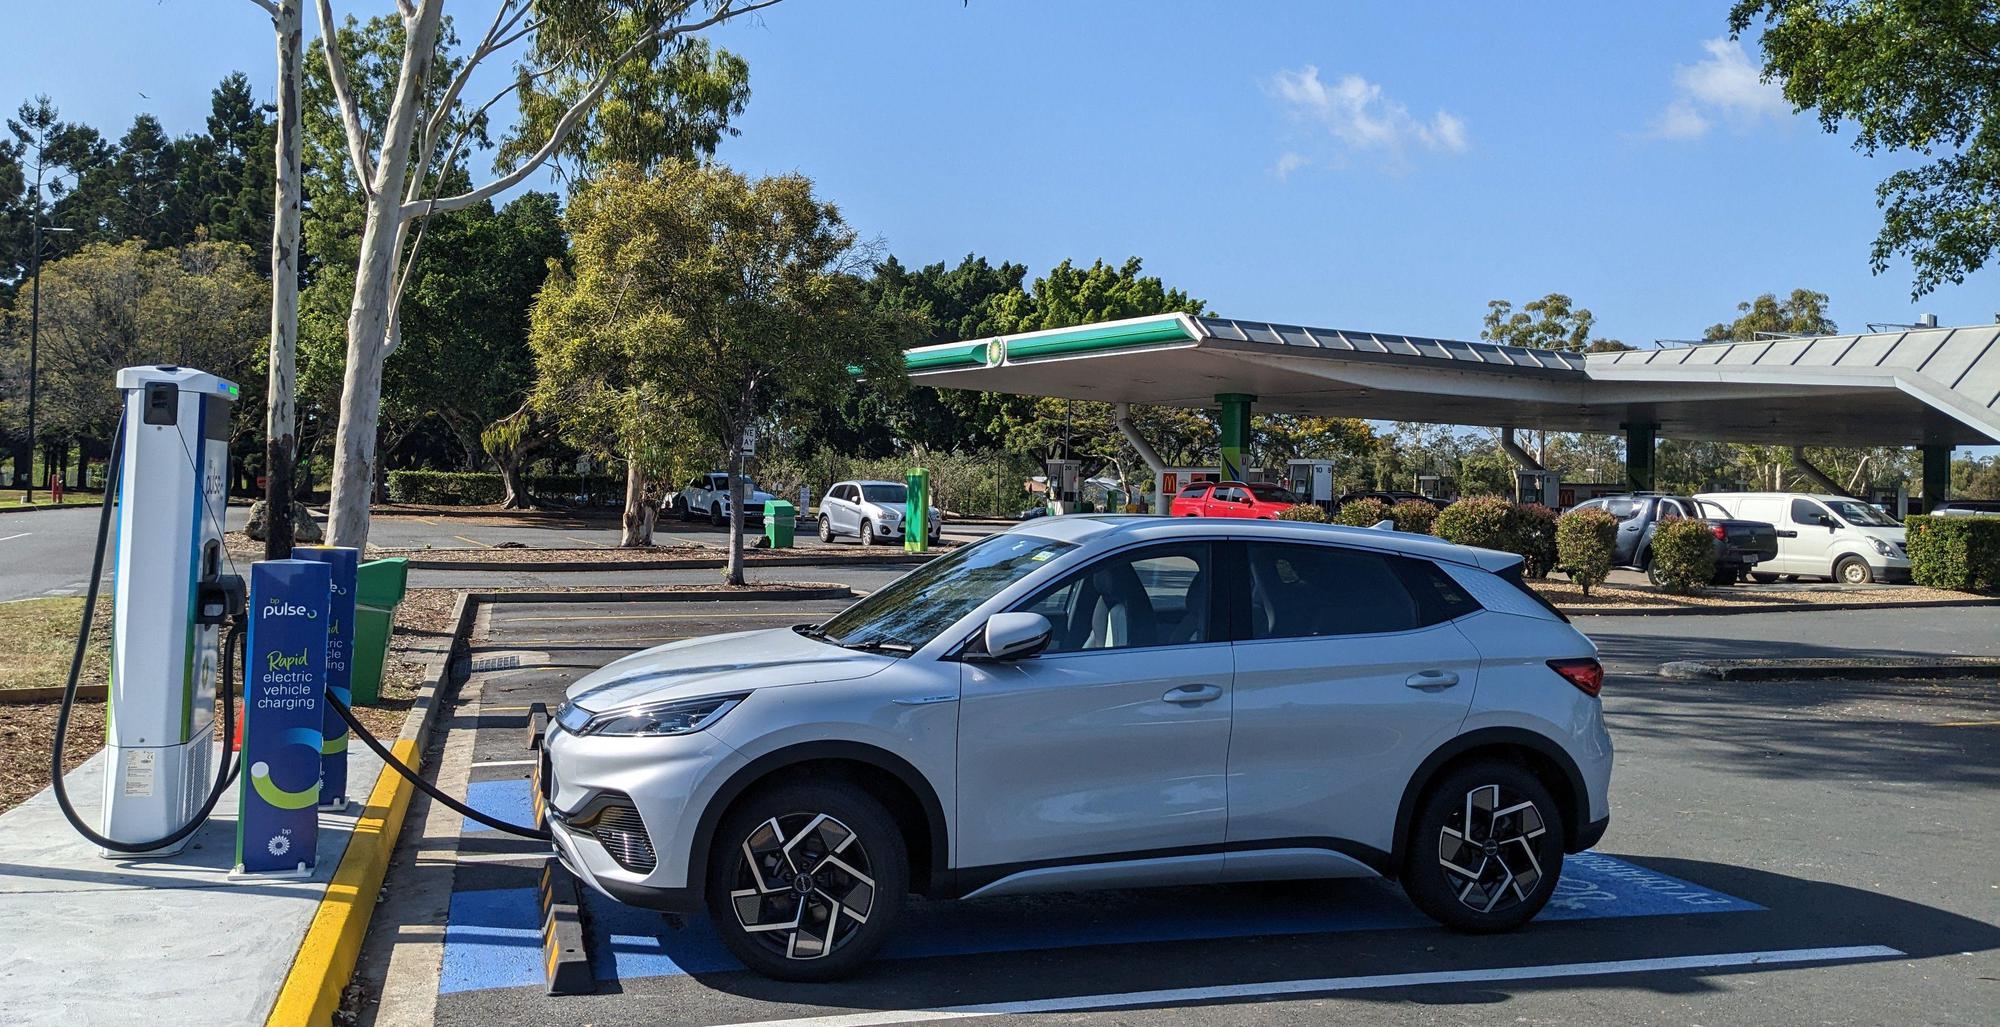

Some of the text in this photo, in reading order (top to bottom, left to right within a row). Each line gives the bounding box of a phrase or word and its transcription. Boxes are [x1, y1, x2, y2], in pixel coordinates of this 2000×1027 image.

[263, 602, 307, 619] pulse
[267, 647, 308, 671] Rapid
[263, 671, 313, 683] electric
[263, 684, 311, 695] vehicle
[257, 696, 315, 710] charging
